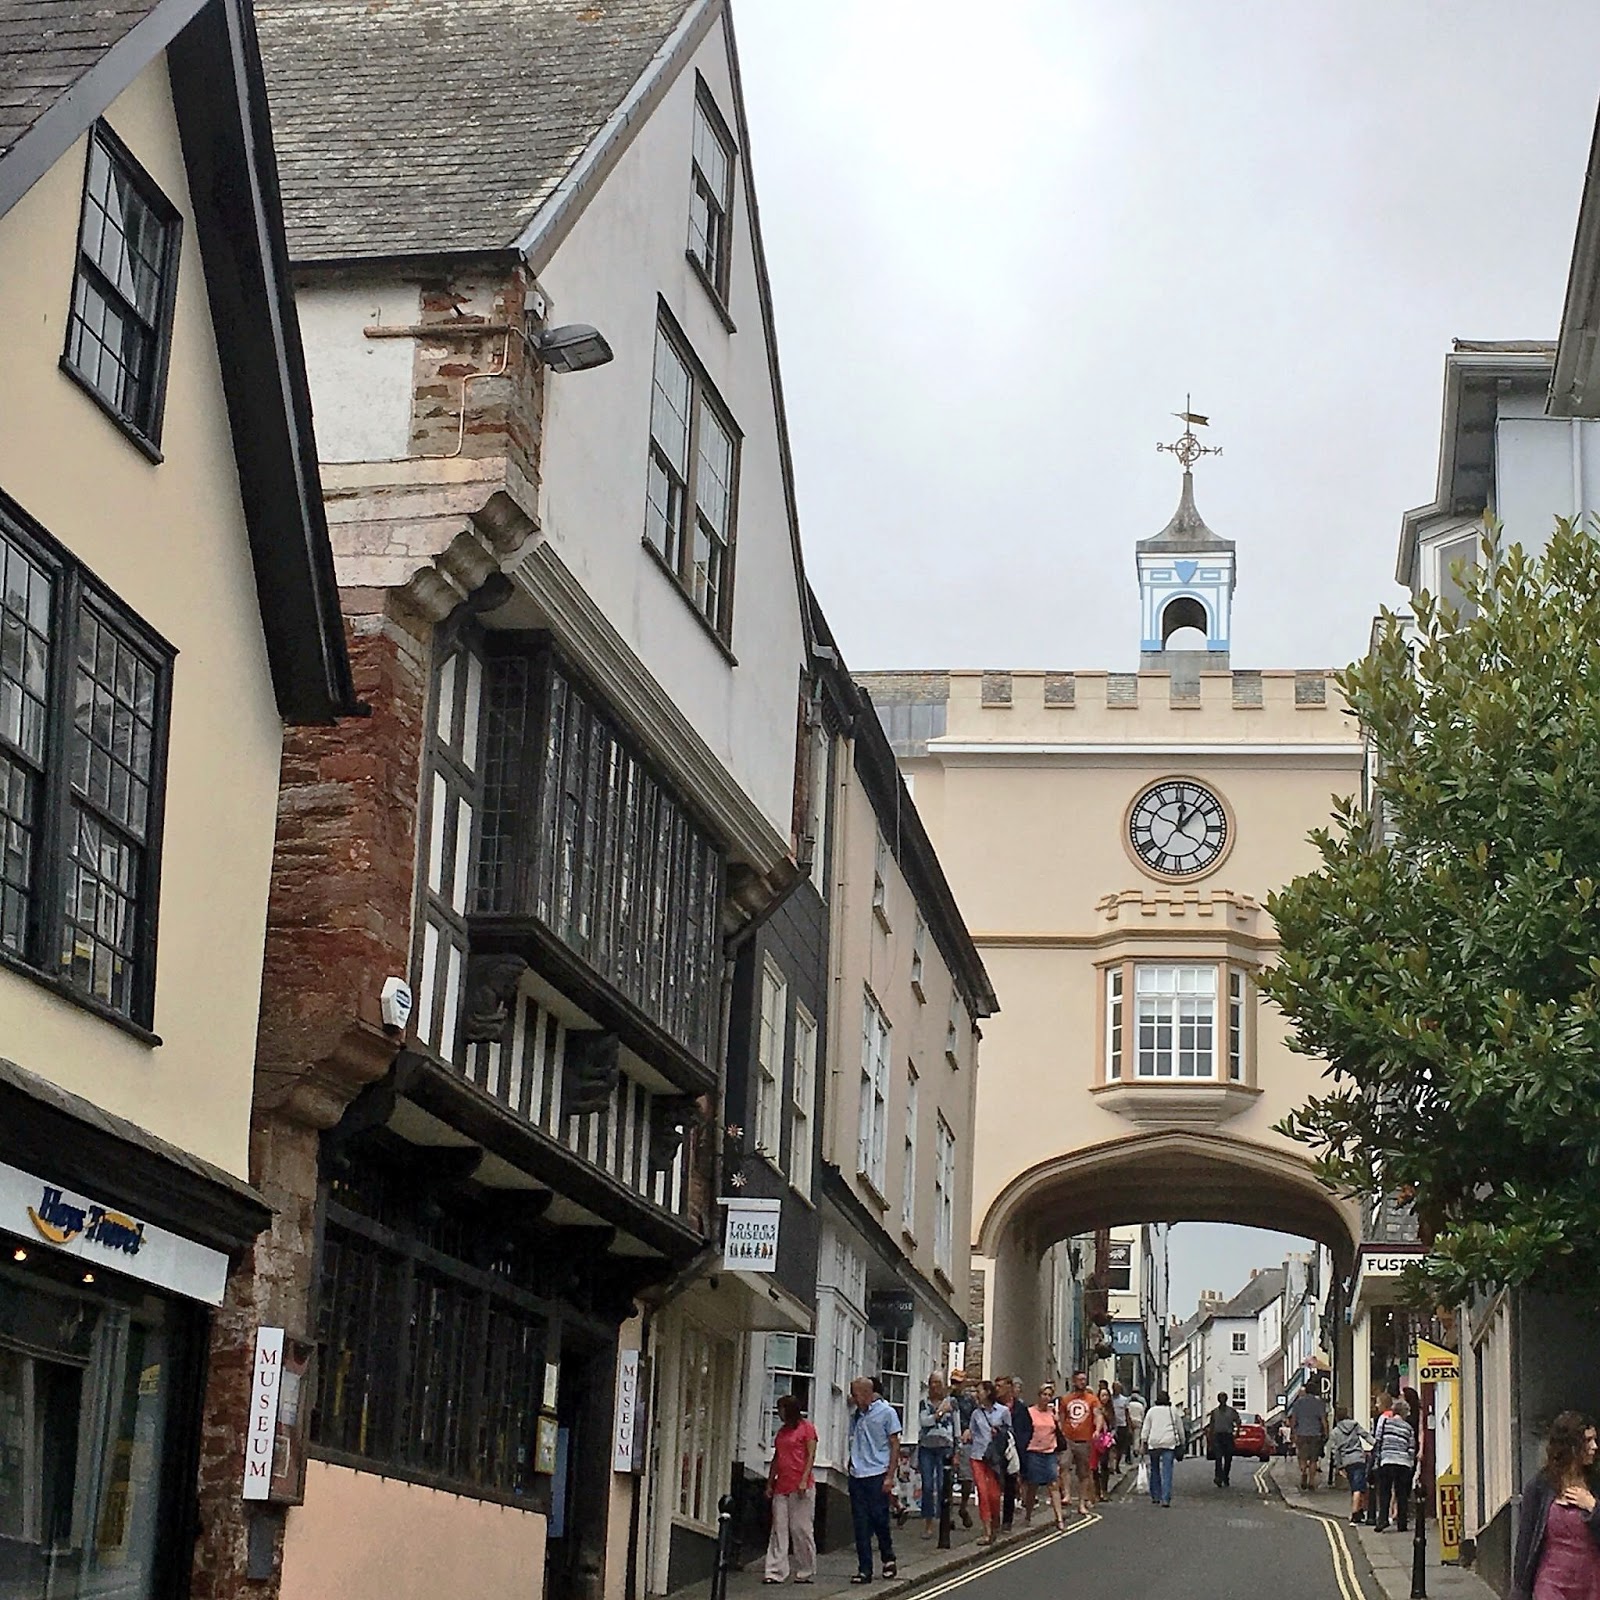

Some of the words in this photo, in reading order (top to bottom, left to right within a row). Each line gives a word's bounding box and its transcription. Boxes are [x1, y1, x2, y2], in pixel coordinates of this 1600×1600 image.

[729, 1221, 776, 1232] Totnes
[729, 1231, 776, 1240] MUSEUM
[1366, 1258, 1424, 1271] FUSI
[1420, 1367, 1460, 1379] OPEN
[250, 1348, 278, 1478] MUSEUM
[618, 1364, 636, 1456] MUSEUM
